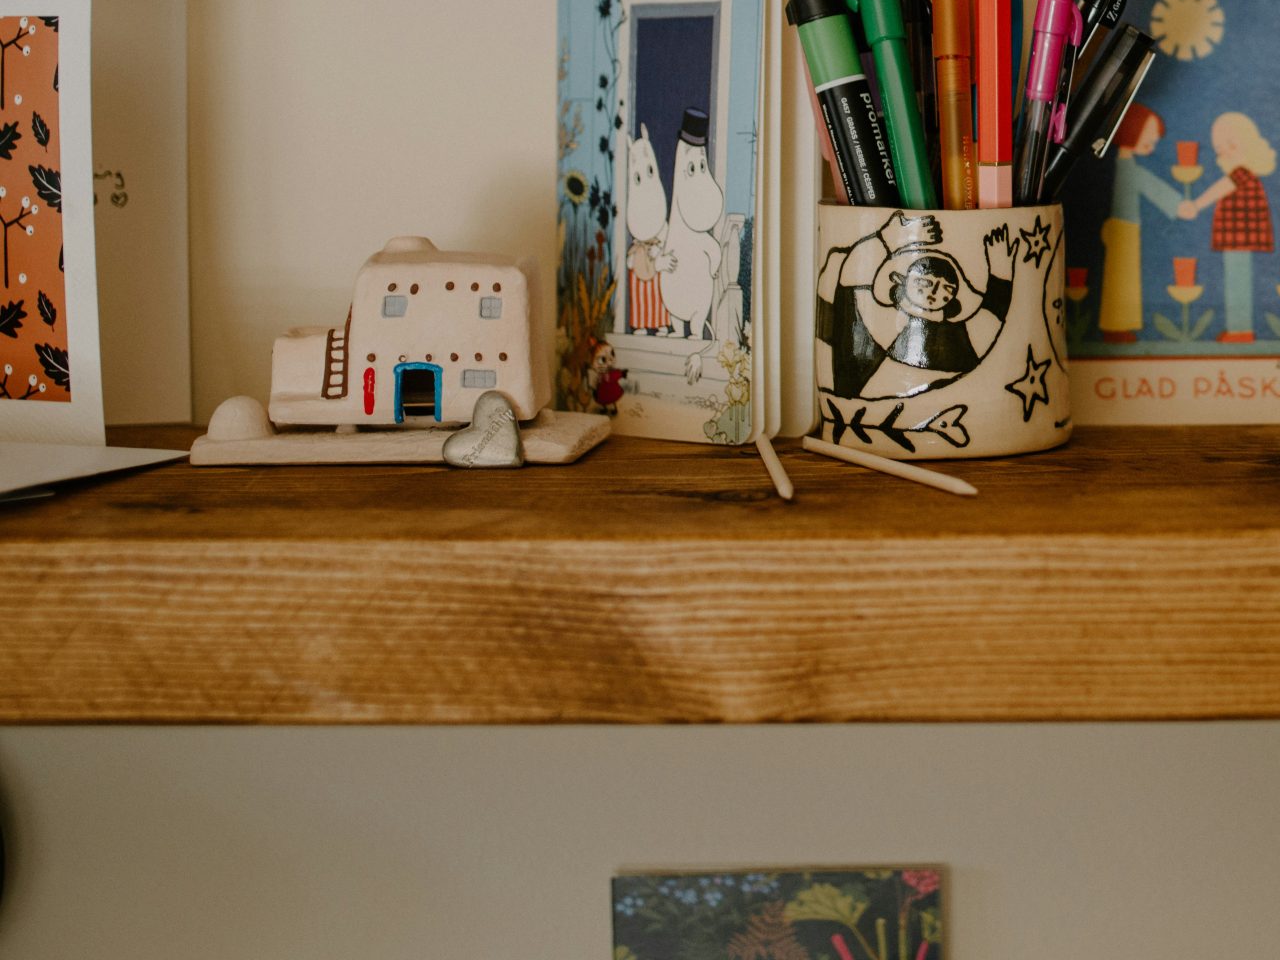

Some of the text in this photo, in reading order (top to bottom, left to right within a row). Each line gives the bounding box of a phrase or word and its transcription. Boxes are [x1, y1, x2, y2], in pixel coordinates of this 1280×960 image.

[846, 116, 858, 140] GRASS
[854, 145, 867, 168] HERBE
[860, 92, 897, 186] promarker
[1094, 377, 1177, 400] GLAD
